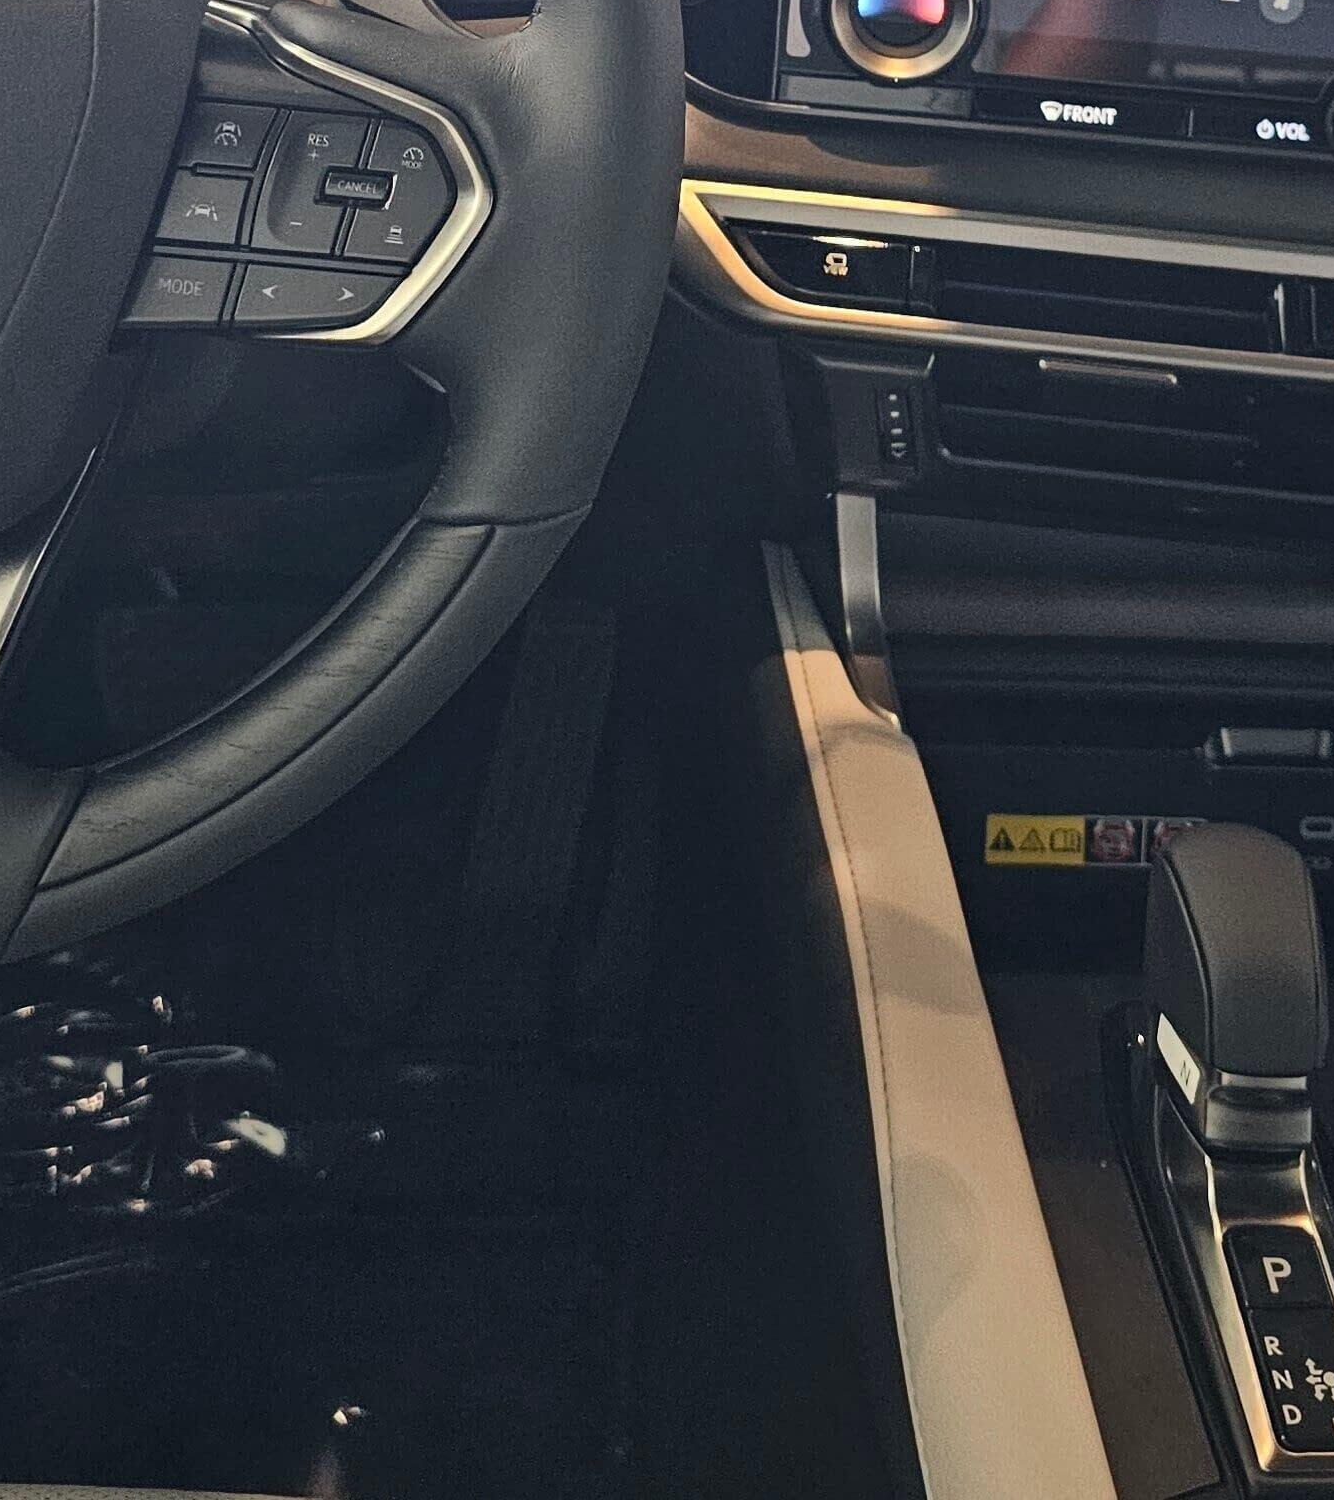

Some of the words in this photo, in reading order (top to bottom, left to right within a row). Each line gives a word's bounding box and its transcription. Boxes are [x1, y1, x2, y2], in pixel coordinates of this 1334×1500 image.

[1063, 103, 1118, 126] FRONT
[307, 132, 330, 149] RES
[1275, 121, 1311, 142] VOL
[336, 179, 379, 196] CANCEL
[157, 276, 206, 298] MODE
[1262, 1256, 1292, 1294] P
[1264, 1336, 1284, 1356] R
[1271, 1369, 1294, 1390] N
[1282, 1404, 1302, 1425] D
